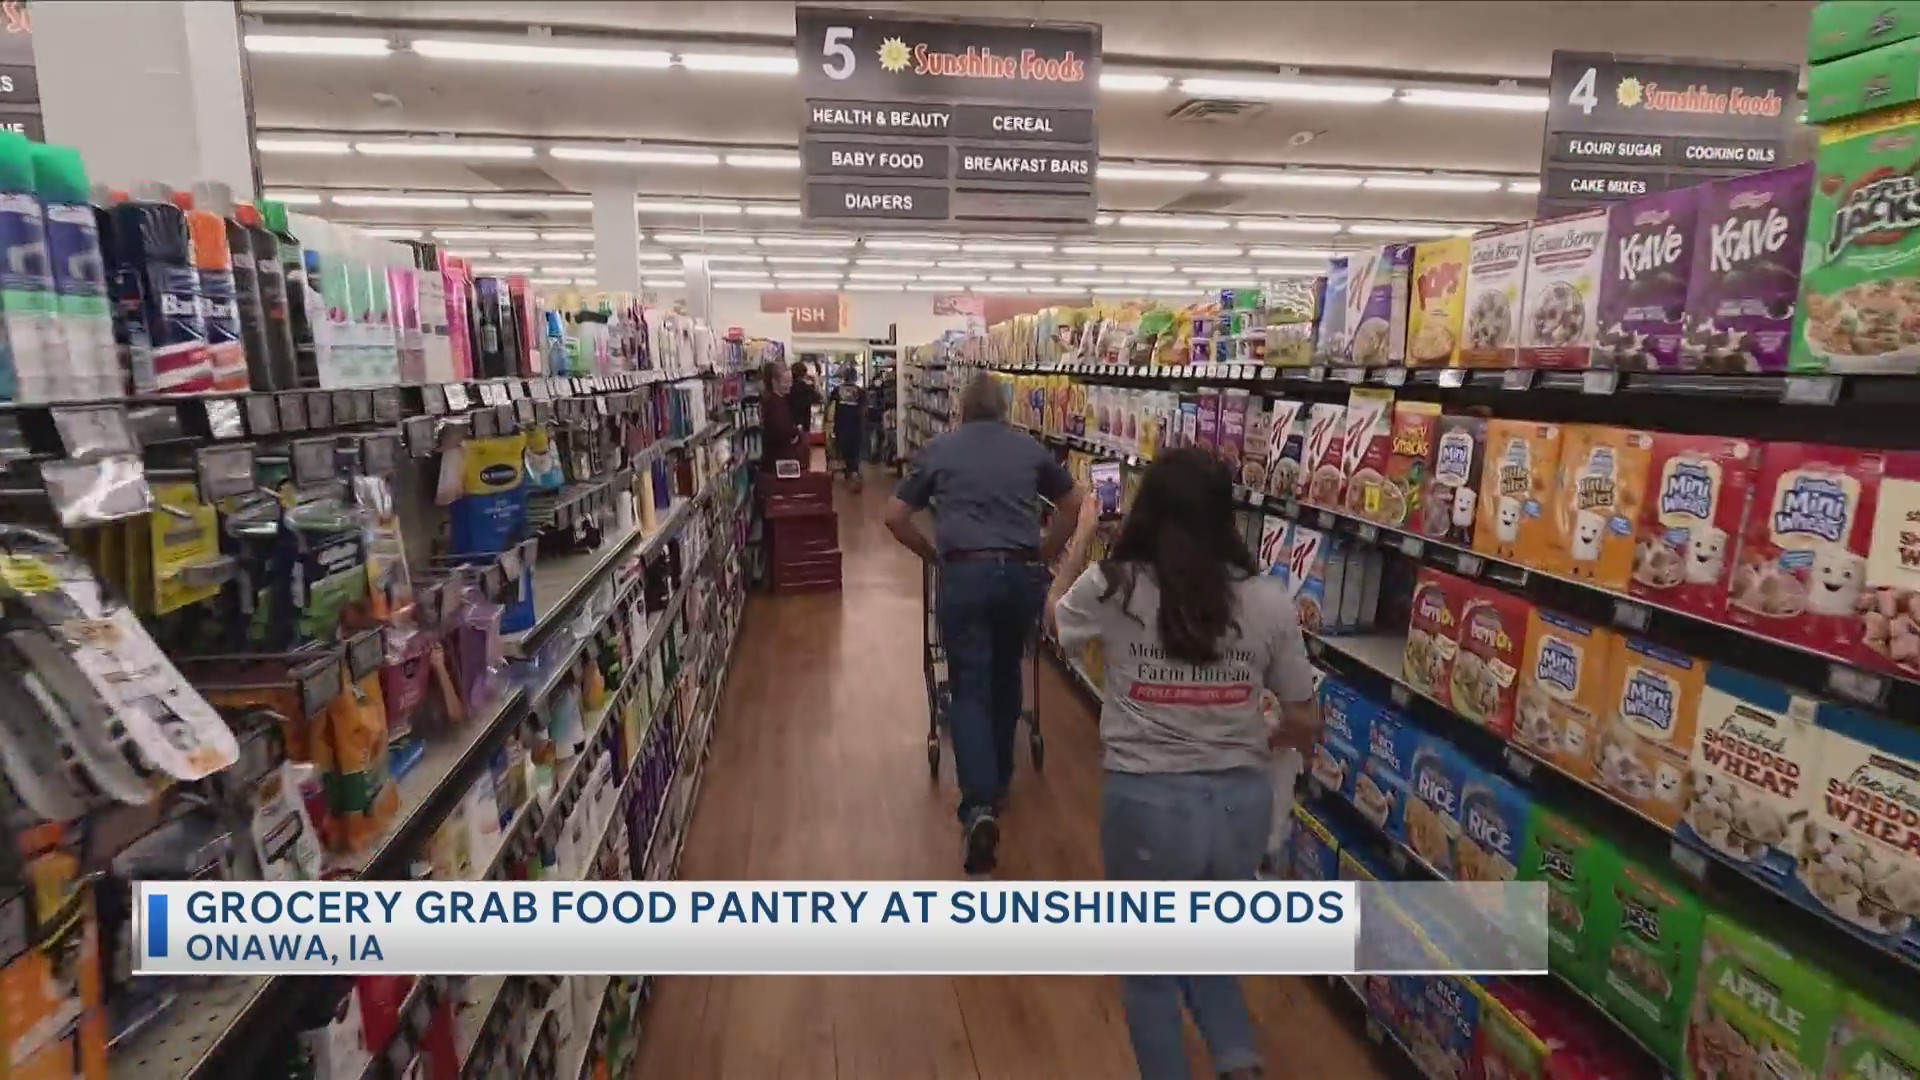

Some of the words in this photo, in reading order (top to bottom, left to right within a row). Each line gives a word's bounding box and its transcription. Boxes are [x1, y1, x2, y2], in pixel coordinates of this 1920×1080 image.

[822, 26, 856, 80] 5
[914, 43, 1017, 79] Sunshine
[1021, 49, 1084, 81] Foods
[1568, 67, 1598, 115] 4
[1644, 82, 1726, 114] Sunshine
[1728, 86, 1783, 117] Foods
[813, 109, 872, 126] HEALTH
[876, 111, 888, 126] &
[890, 111, 950, 128] BEAUTY
[992, 115, 1053, 132] CEREAL
[832, 151, 875, 168] BABY
[879, 153, 924, 170] FOOD
[1618, 142, 1662, 158] SUGAR
[1686, 145, 1744, 162] COOKING
[1747, 148, 1776, 162] OILS
[964, 156, 1047, 173] BREAKFAST
[1050, 158, 1089, 175] BARS
[1571, 178, 1605, 193] CAKE
[1607, 180, 1647, 194] MIXES
[845, 193, 913, 211] DIAPERS
[1669, 475, 1710, 498] Mini
[1785, 490, 1847, 519] Mini
[1138, 662, 1184, 681] Farm
[1631, 681, 1671, 711] Mini
[1704, 728, 1799, 778] SHREDDED
[1702, 742, 1799, 799] WHEAT
[1418, 767, 1456, 813] RICE
[1468, 806, 1513, 855] RICE
